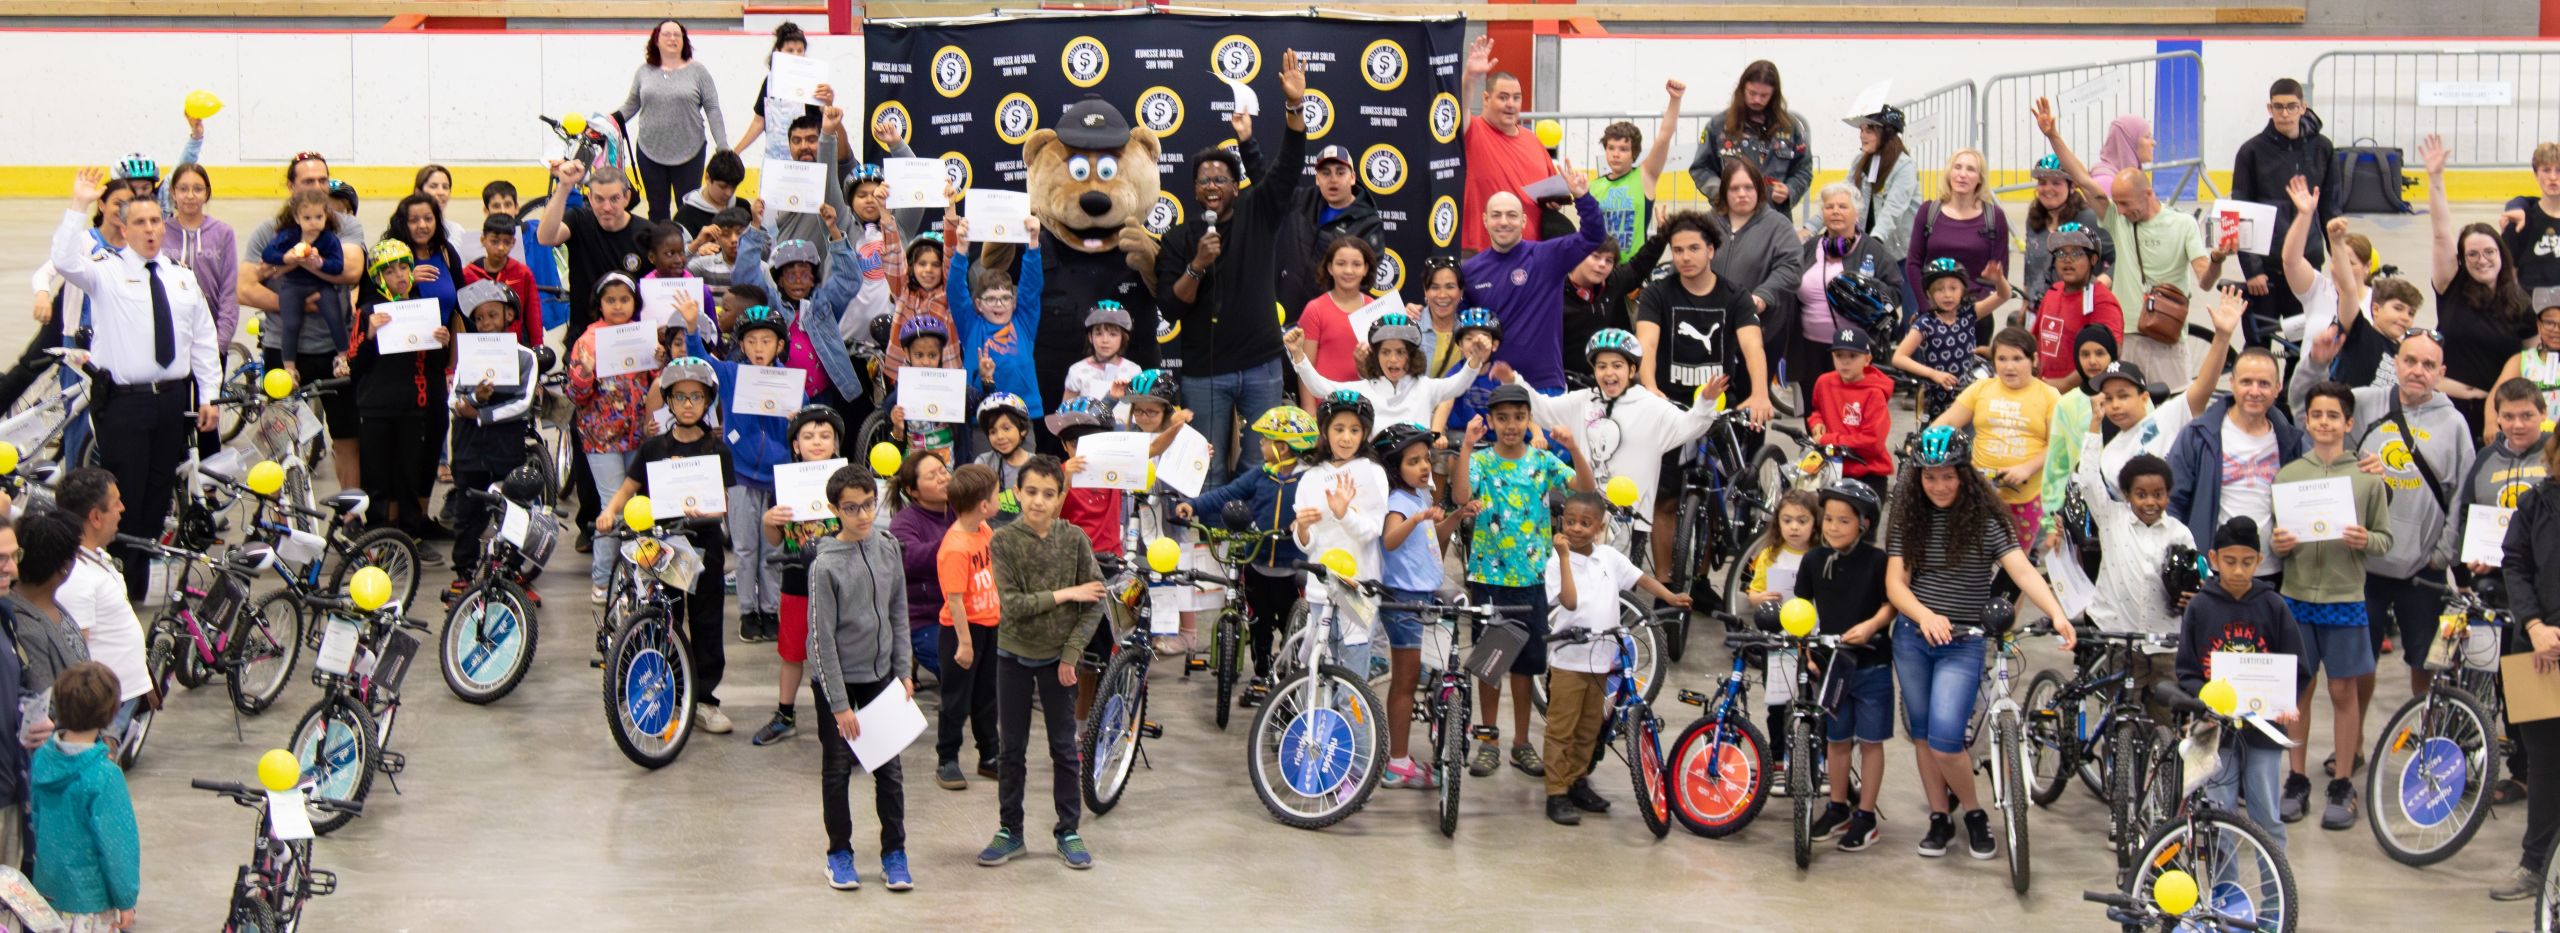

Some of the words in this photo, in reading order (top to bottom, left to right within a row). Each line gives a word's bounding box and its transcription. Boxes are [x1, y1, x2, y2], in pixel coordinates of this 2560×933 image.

[1135, 49, 1159, 58] JEUNESSE
[1160, 49, 1167, 58] AU
[1167, 49, 1184, 59] SOLEIL
[1320, 52, 1336, 62] SOLEIL
[993, 56, 1014, 67] JEUNESSE
[1021, 54, 1036, 64] SOLEIL
[1146, 60, 1156, 70] SUN
[1156, 60, 1174, 70] YOUTH
[1003, 68, 1012, 77] SUN
[1012, 66, 1028, 76] YOUTH
[1310, 63, 1326, 72] YOUTH
[1360, 106, 1383, 115] JEUNESSE
[1384, 106, 1392, 116] AU
[1392, 107, 1408, 117] SOLEIL
[932, 114, 951, 125] JEUNESSE
[958, 112, 972, 122] SOLEIL
[1370, 117, 1381, 126] SUN
[1381, 118, 1397, 127] YOUTH
[940, 126, 950, 136] SUN
[950, 124, 964, 134] YOUTH
[1167, 154, 1184, 163] SOLEIL
[1390, 211, 1407, 220] SOLEIL
[1384, 222, 1397, 230] OUTH
[1842, 329, 1854, 342] NY
[1670, 364, 1724, 386] PUMA
[2240, 656, 2273, 665] CERTIFICAT
